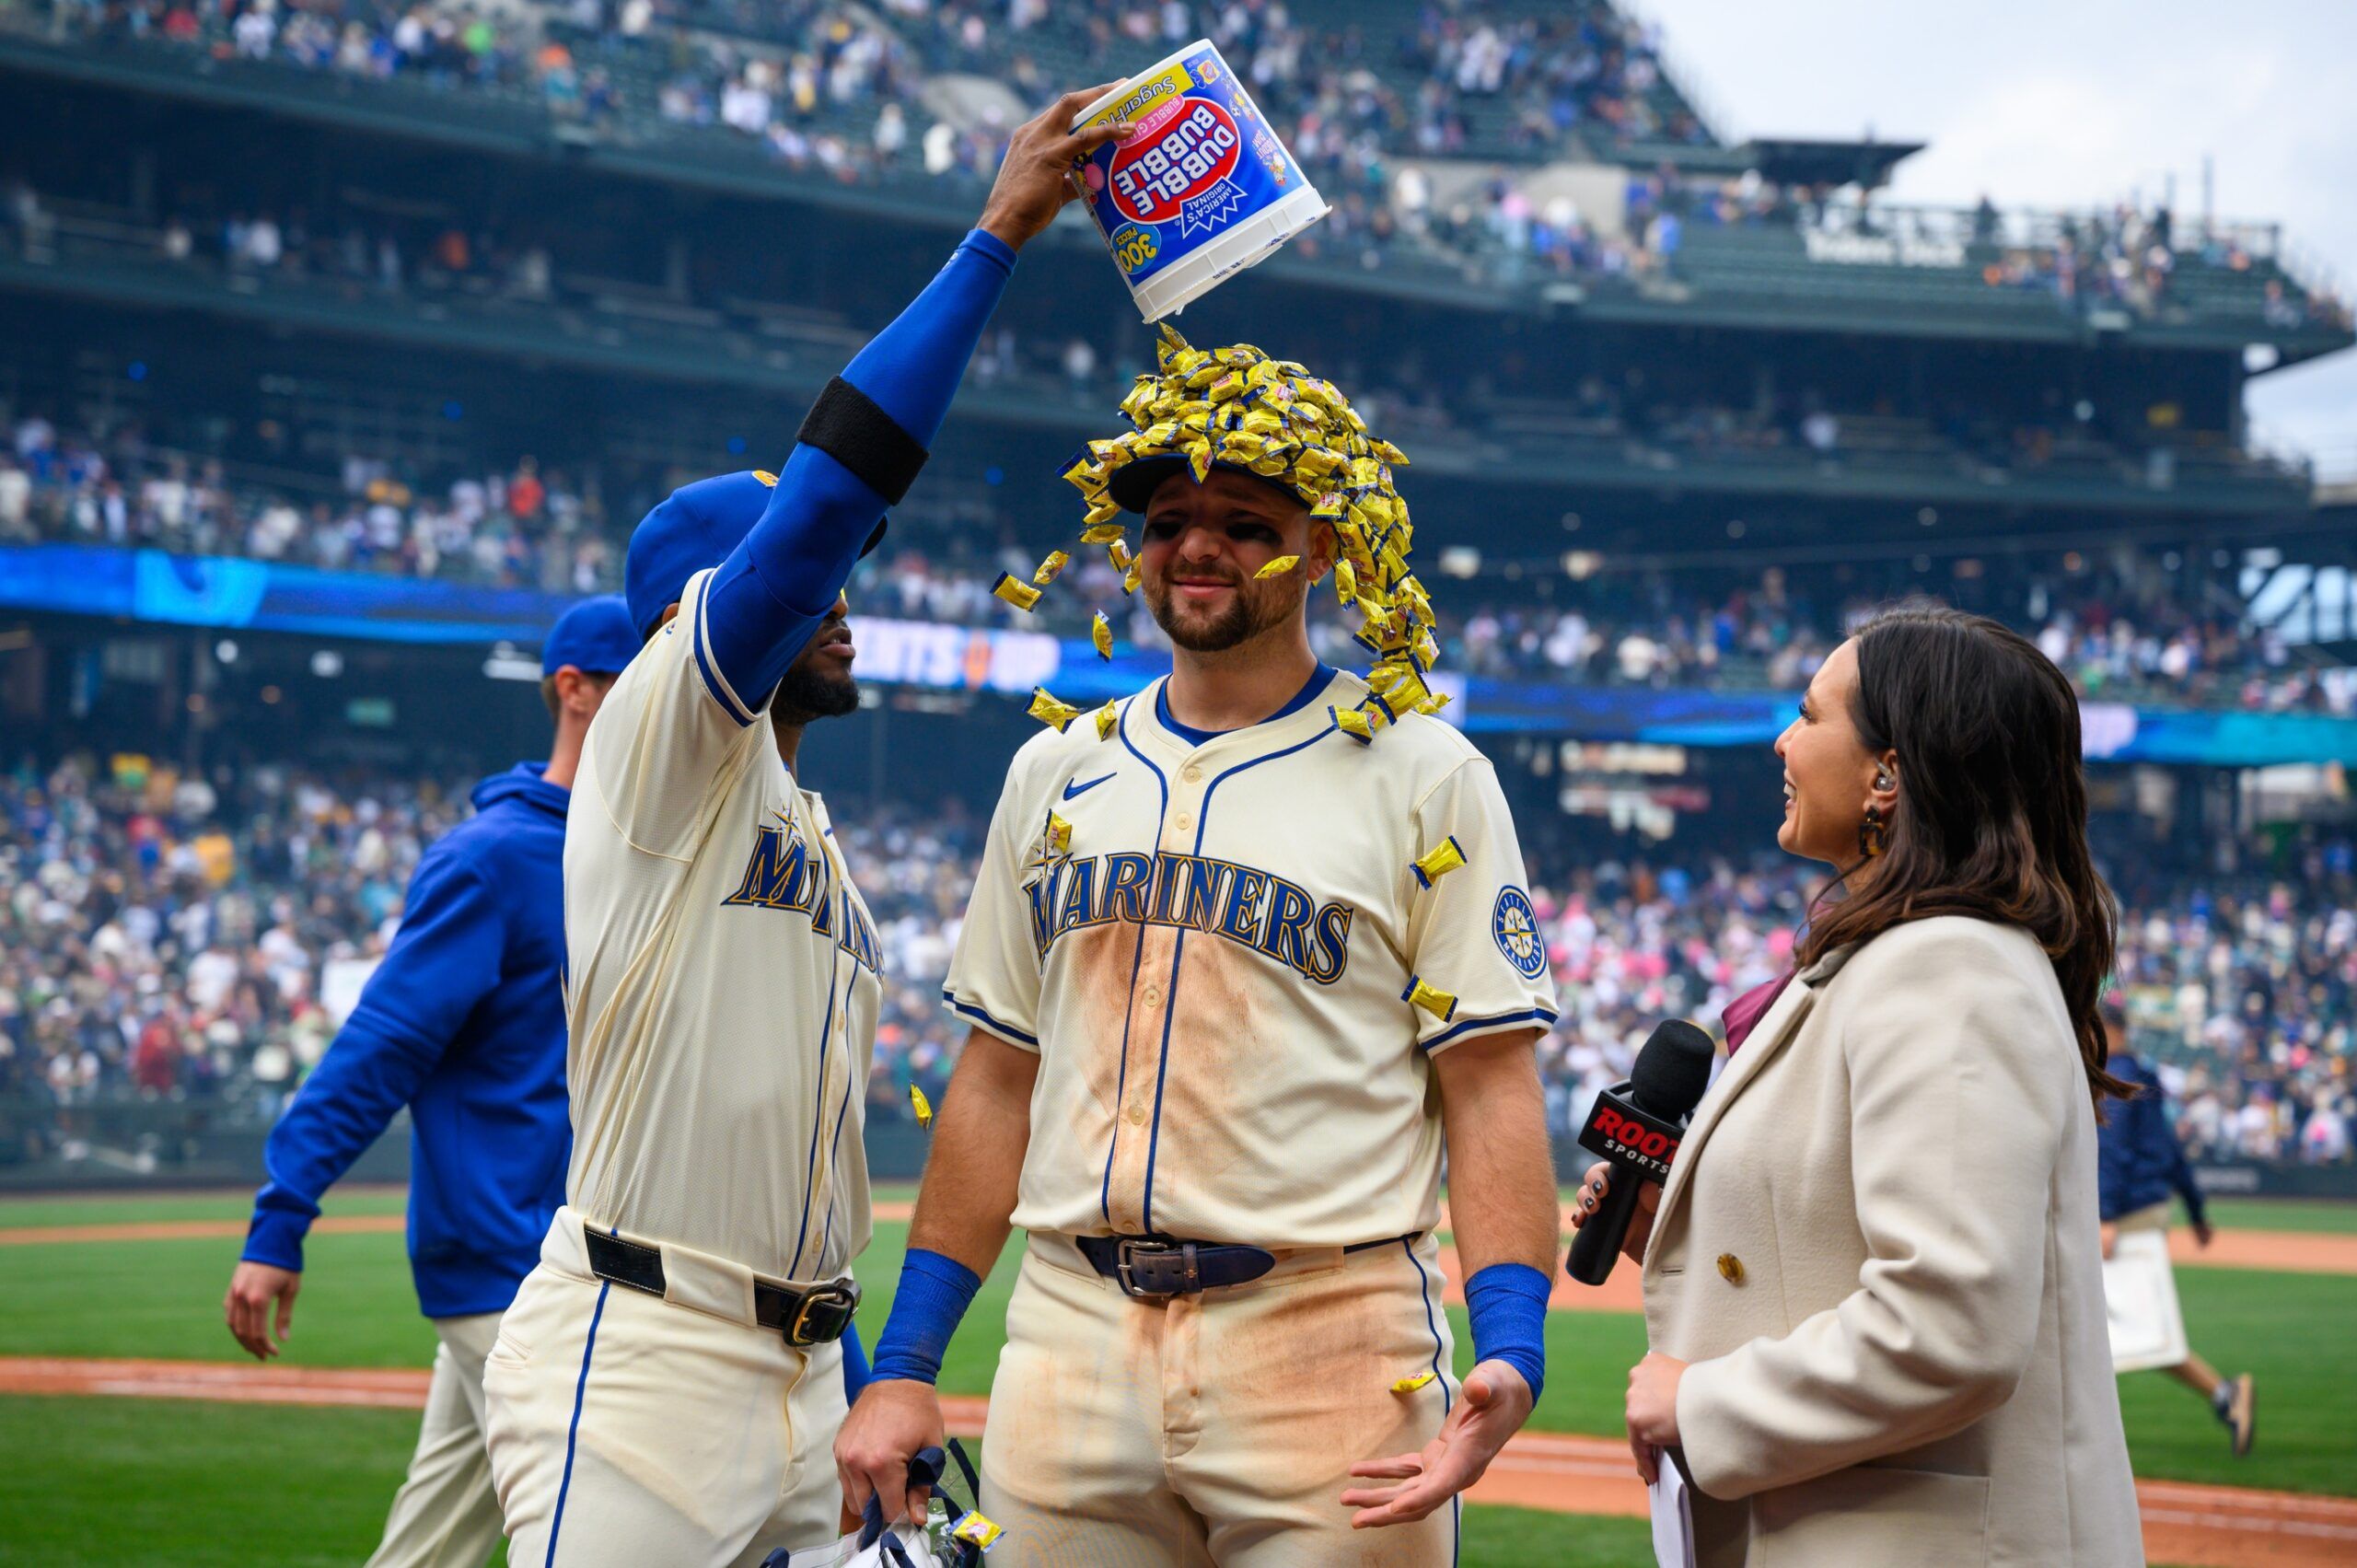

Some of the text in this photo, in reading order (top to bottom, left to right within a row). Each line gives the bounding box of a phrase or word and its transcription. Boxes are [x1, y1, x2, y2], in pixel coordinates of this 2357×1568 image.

[1151, 97, 1180, 128] BUBBLE
[1114, 104, 1216, 196] BUBBLE
[1132, 124, 1236, 216] DUBBLE
[1187, 182, 1226, 212] ORIGINAL
[1188, 186, 1233, 223] AMERICA'S
[1116, 226, 1138, 247] PIECES
[1119, 232, 1157, 273] 300
[1022, 851, 1354, 986] MARINERS
[1497, 894, 1532, 923] SEATTLE
[1503, 940, 1541, 970] MARINERS
[1605, 1138, 1669, 1174] SPORTS
